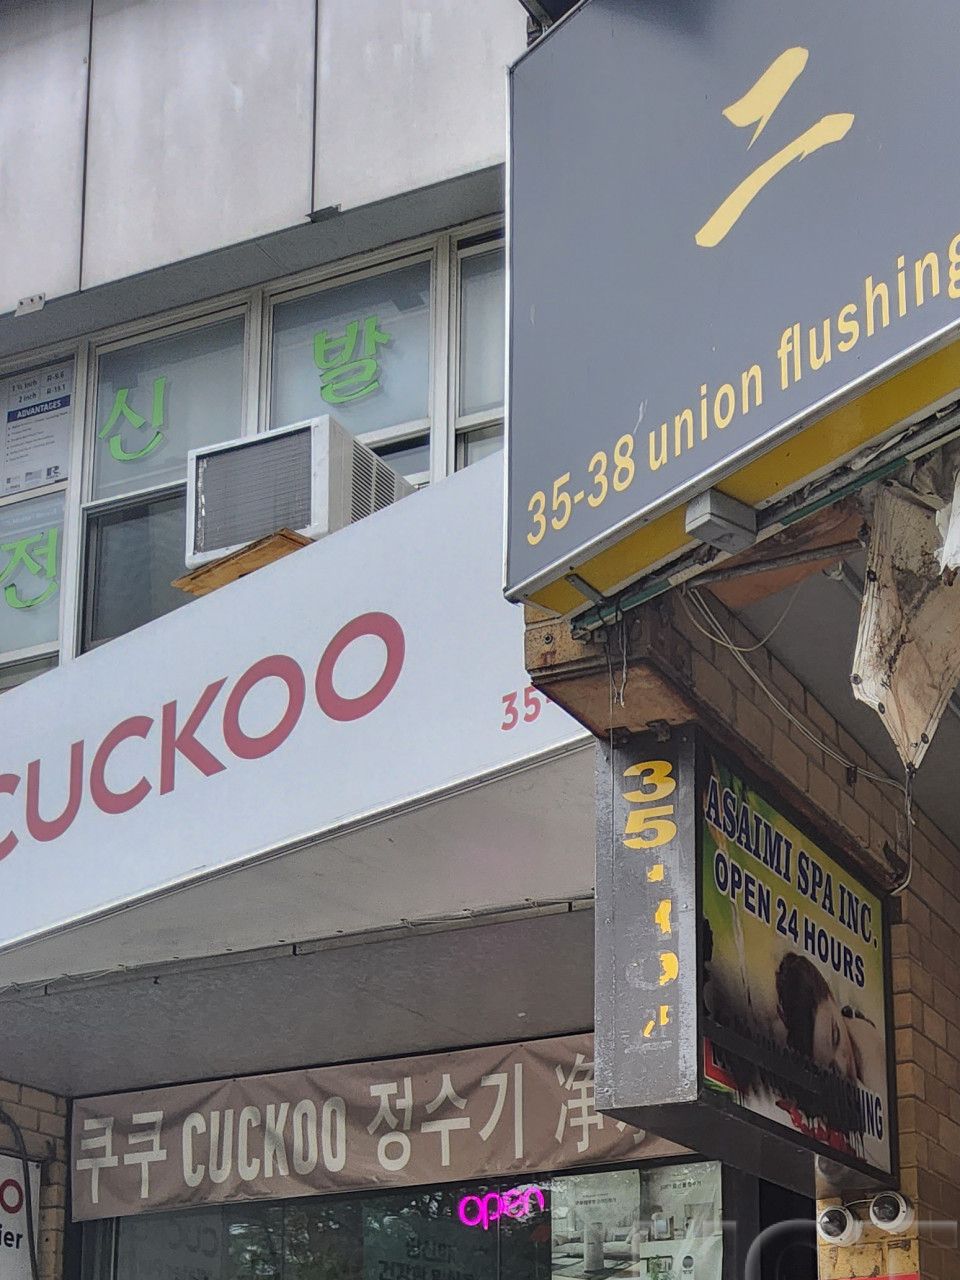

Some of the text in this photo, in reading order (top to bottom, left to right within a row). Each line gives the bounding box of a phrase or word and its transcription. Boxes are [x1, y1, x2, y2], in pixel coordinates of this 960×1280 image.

[16, 400, 62, 418] ADVANTAGES
[526, 434, 635, 546] 35-38
[648, 364, 763, 471] union
[705, 775, 879, 949] ASAIMI SPA INC.
[713, 853, 866, 988] OPEN 24 HOURS
[76, 1110, 168, 1204] 쿠쿠
[181, 1096, 347, 1187] CUCKOO
[367, 1062, 524, 1172] 정수기
[458, 1184, 545, 1231] open
